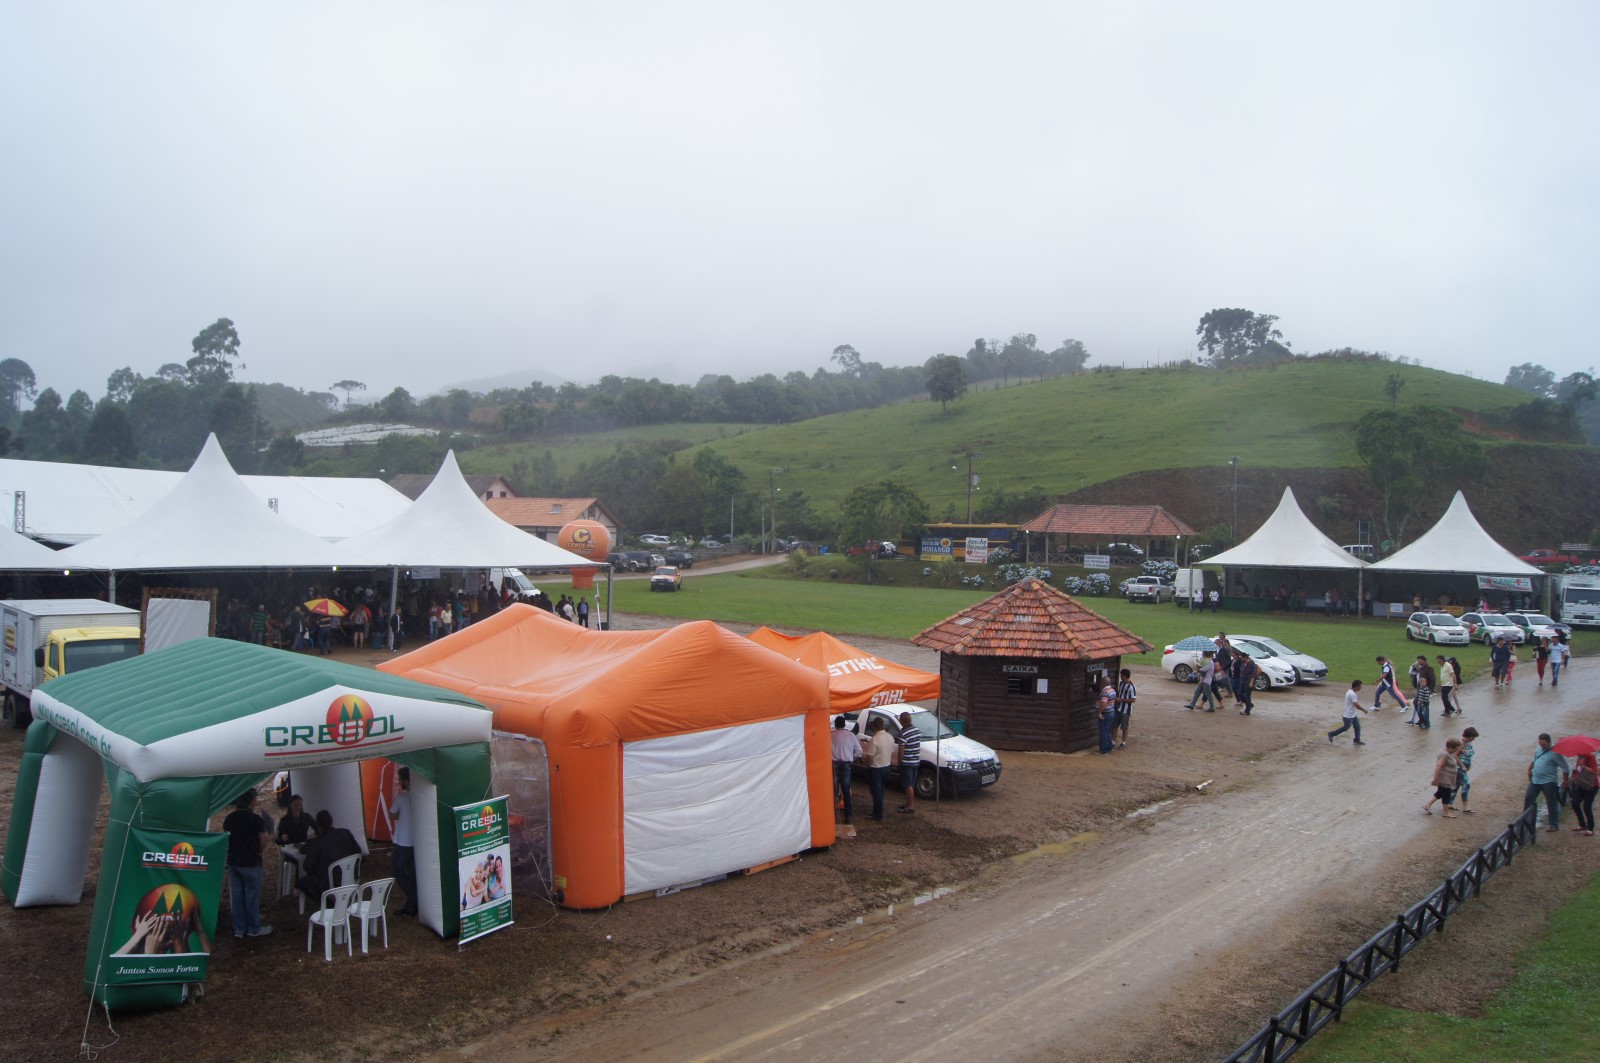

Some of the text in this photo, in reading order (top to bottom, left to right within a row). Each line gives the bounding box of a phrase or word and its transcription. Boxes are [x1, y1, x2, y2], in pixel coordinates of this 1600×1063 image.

[827, 658, 884, 676] STIHL
[1088, 663, 1104, 671] CAIXA
[869, 689, 905, 707] STIHL
[265, 714, 405, 747] CRESOL
[461, 813, 502, 831] CRESOL
[142, 851, 209, 865] CRESOL
[116, 964, 199, 975] Juntos Somos Fortes
